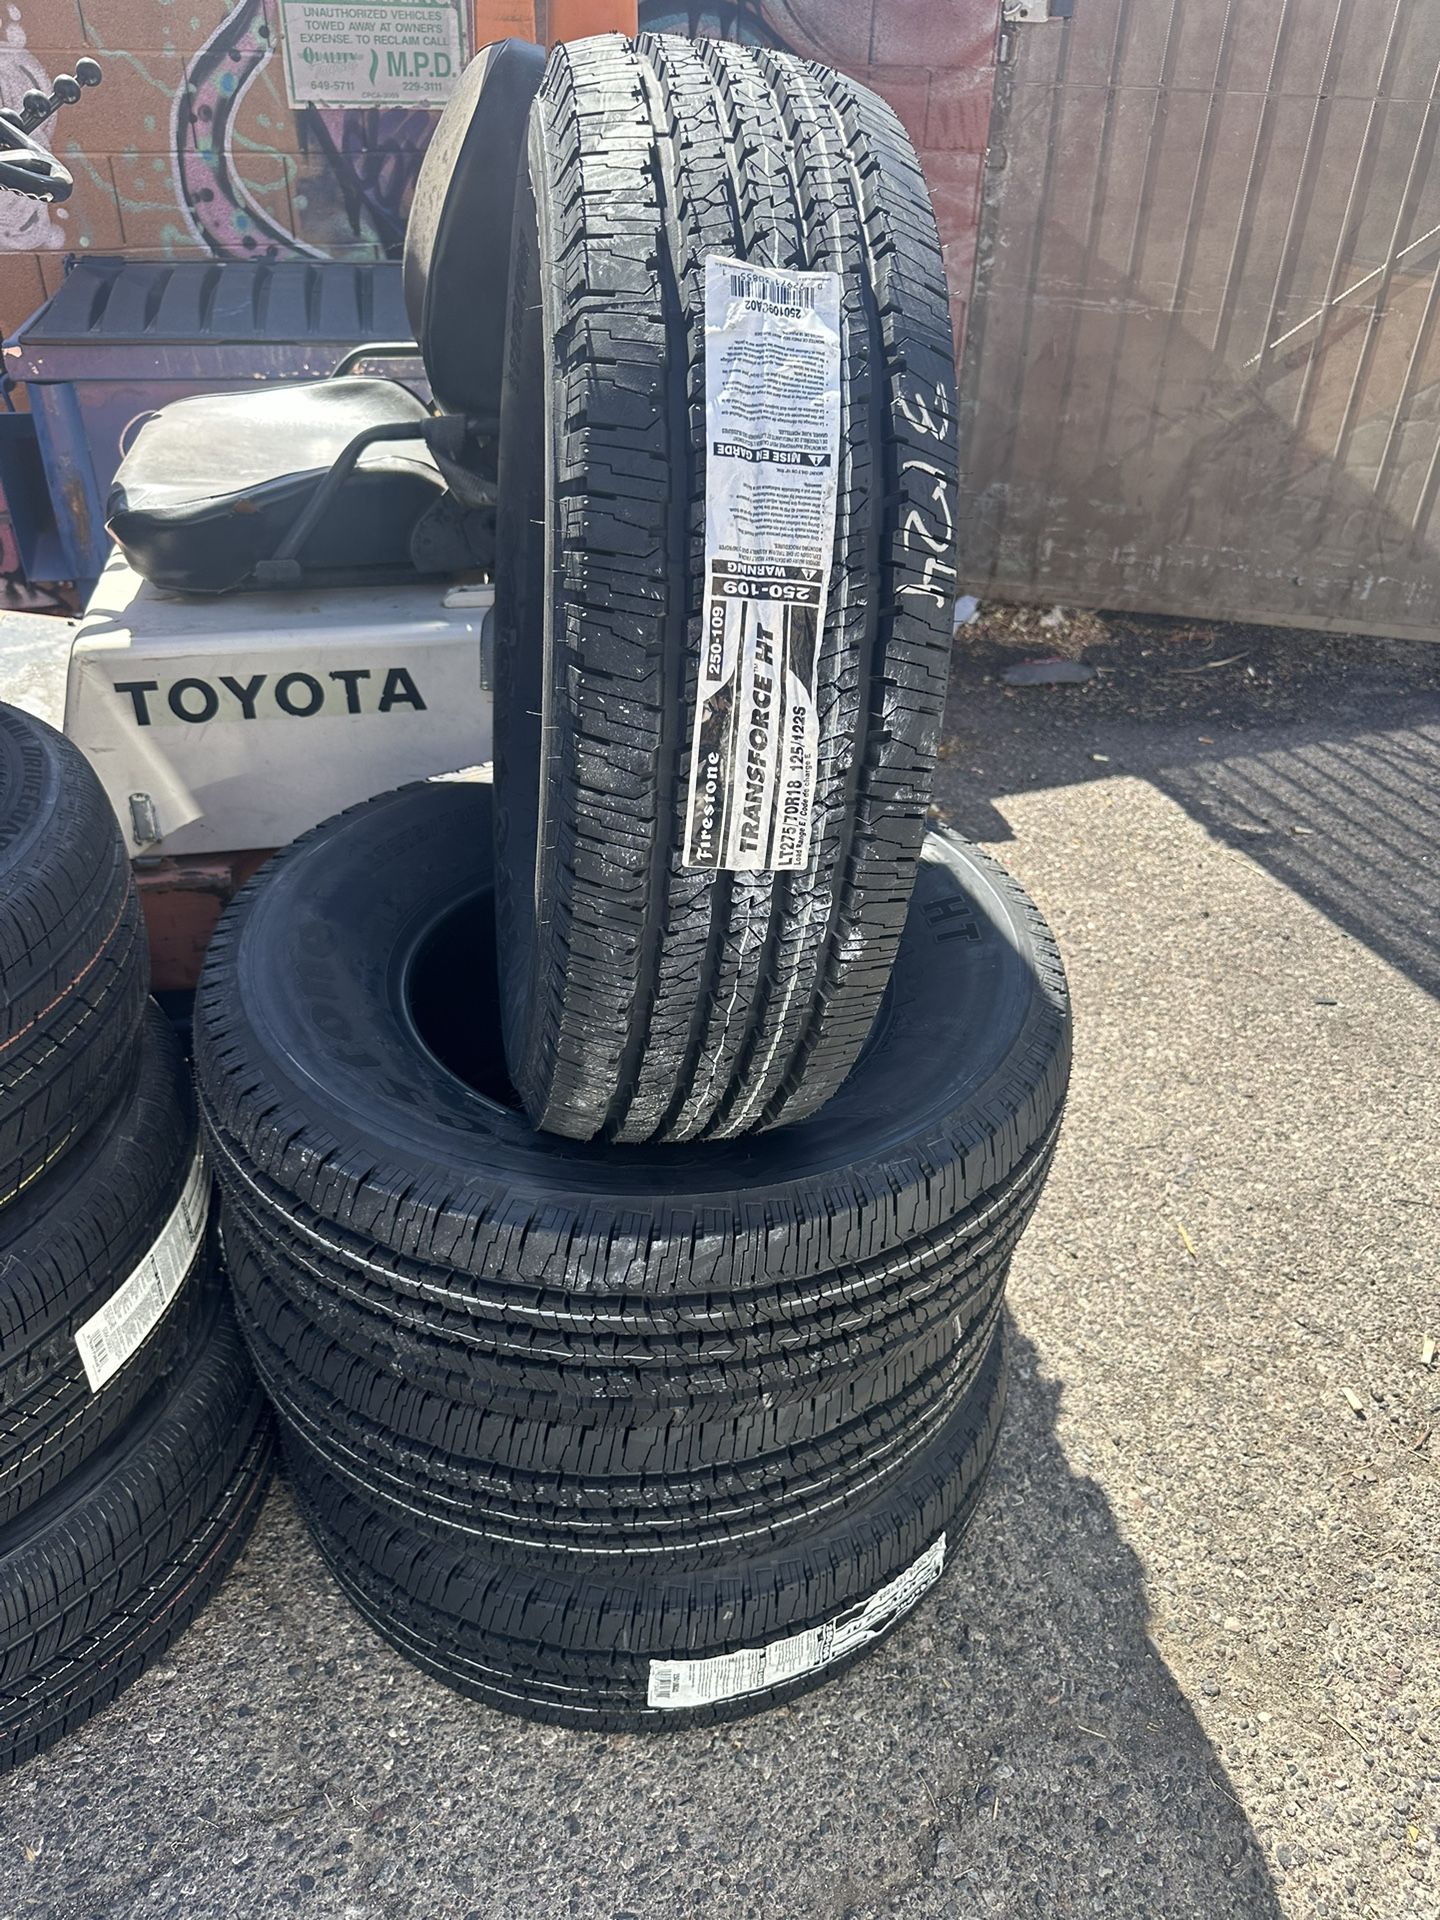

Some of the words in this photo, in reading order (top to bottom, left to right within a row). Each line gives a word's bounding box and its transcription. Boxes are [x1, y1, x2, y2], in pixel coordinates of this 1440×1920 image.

[303, 8, 387, 19] UNAUTHORIZED
[391, 9, 442, 21] VEHICLES
[305, 20, 345, 31] TOWED
[350, 21, 376, 32] AWAY
[379, 22, 392, 32] AT
[395, 23, 443, 33] OWNER'S
[356, 34, 370, 44] TO
[374, 35, 420, 45] RECLAIM
[423, 36, 449, 46] CALL
[387, 51, 457, 77] M.P.D.
[311, 81, 355, 90] 649-5711
[402, 82, 442, 92] 229-3111
[717, 444, 753, 460] GARDE
[756, 450, 769, 461] EN
[773, 452, 801, 463] MISE
[728, 562, 786, 577] WARNNG
[723, 581, 810, 600] 250-109
[708, 606, 724, 674] 250-109
[755, 622, 774, 665] HT
[114, 668, 427, 726] TOYOTA
[790, 706, 806, 772] 125/122S
[803, 761, 812, 786] charge
[696, 752, 720, 861] Firestone
[801, 798, 809, 816] Code
[778, 780, 803, 866] LT275/70R18
[796, 827, 807, 848] Range
[794, 849, 803, 866] Load
